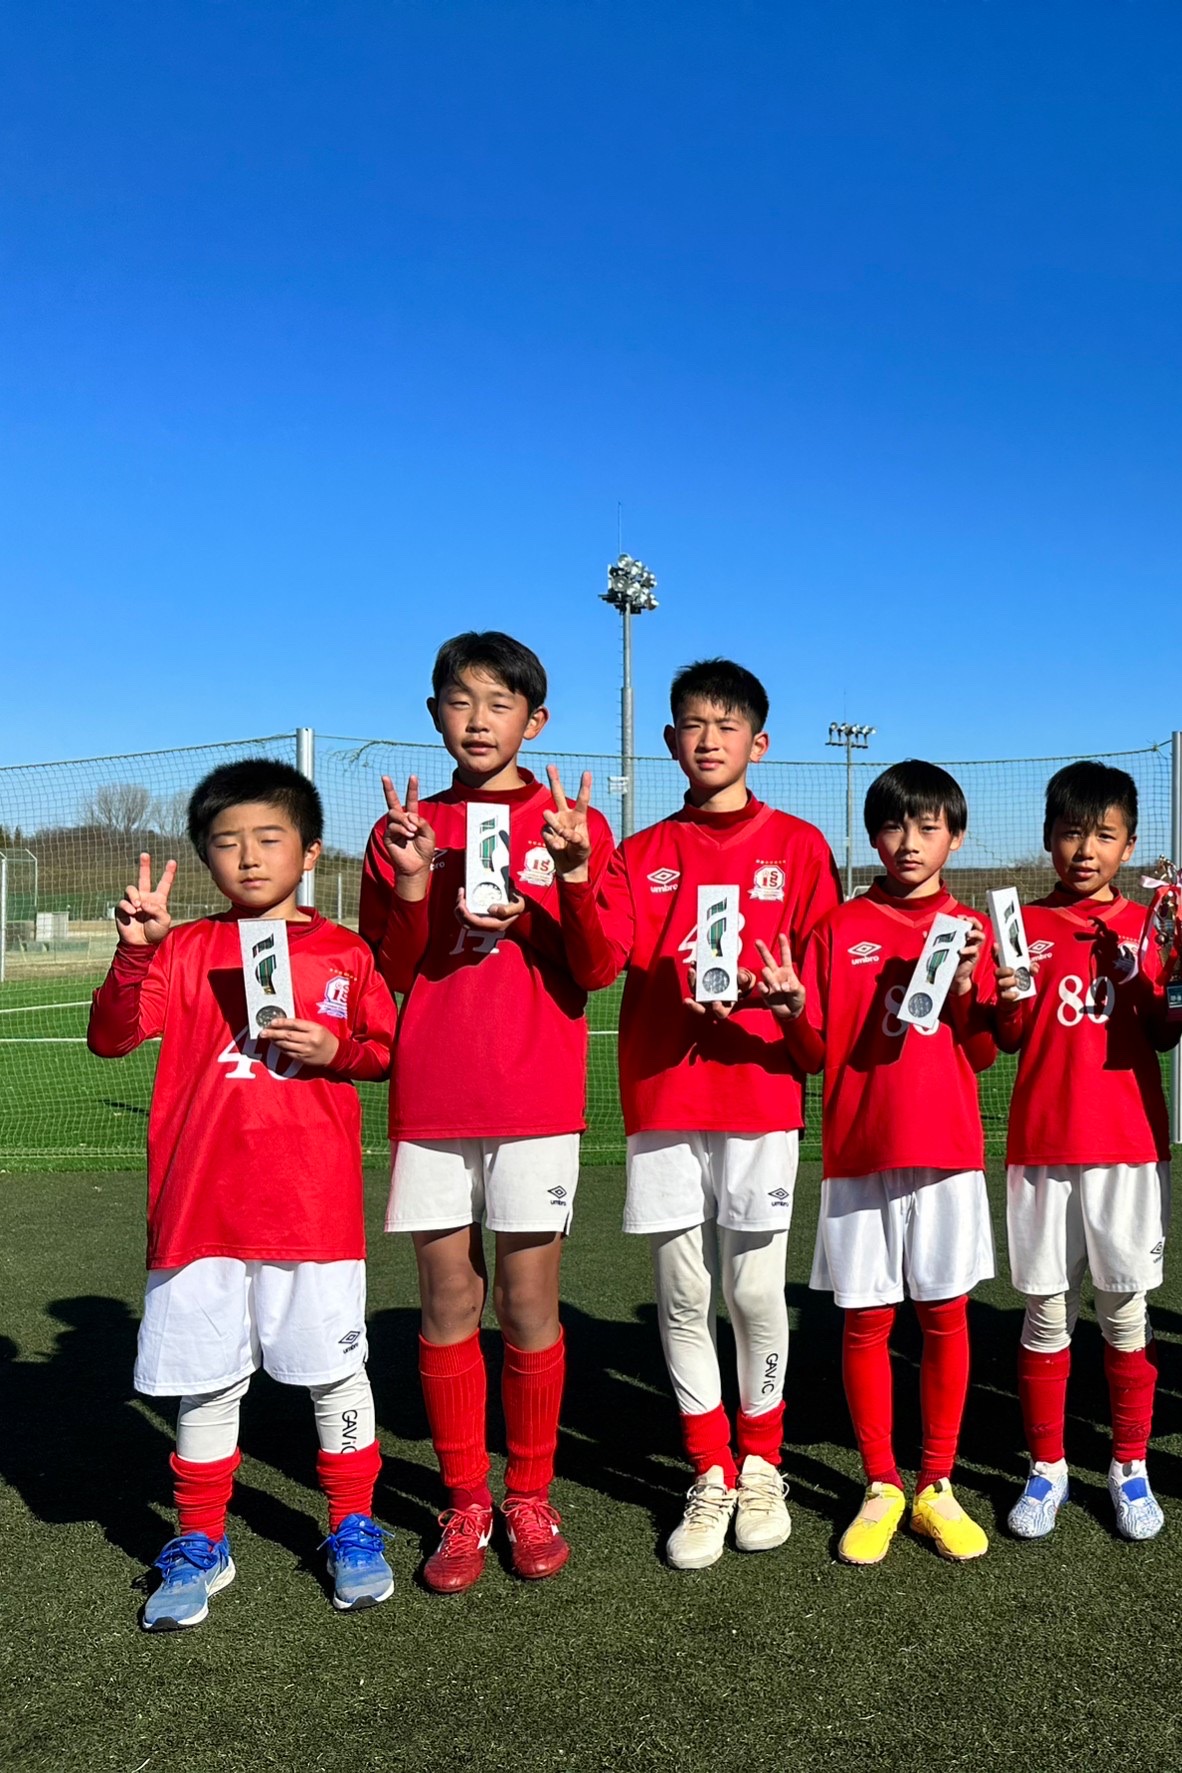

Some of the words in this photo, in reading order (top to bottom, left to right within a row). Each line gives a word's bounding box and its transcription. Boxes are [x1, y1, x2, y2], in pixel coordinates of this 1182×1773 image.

[650, 883, 679, 893] umbro
[851, 955, 880, 966] umbro
[1056, 974, 1115, 1027] 80
